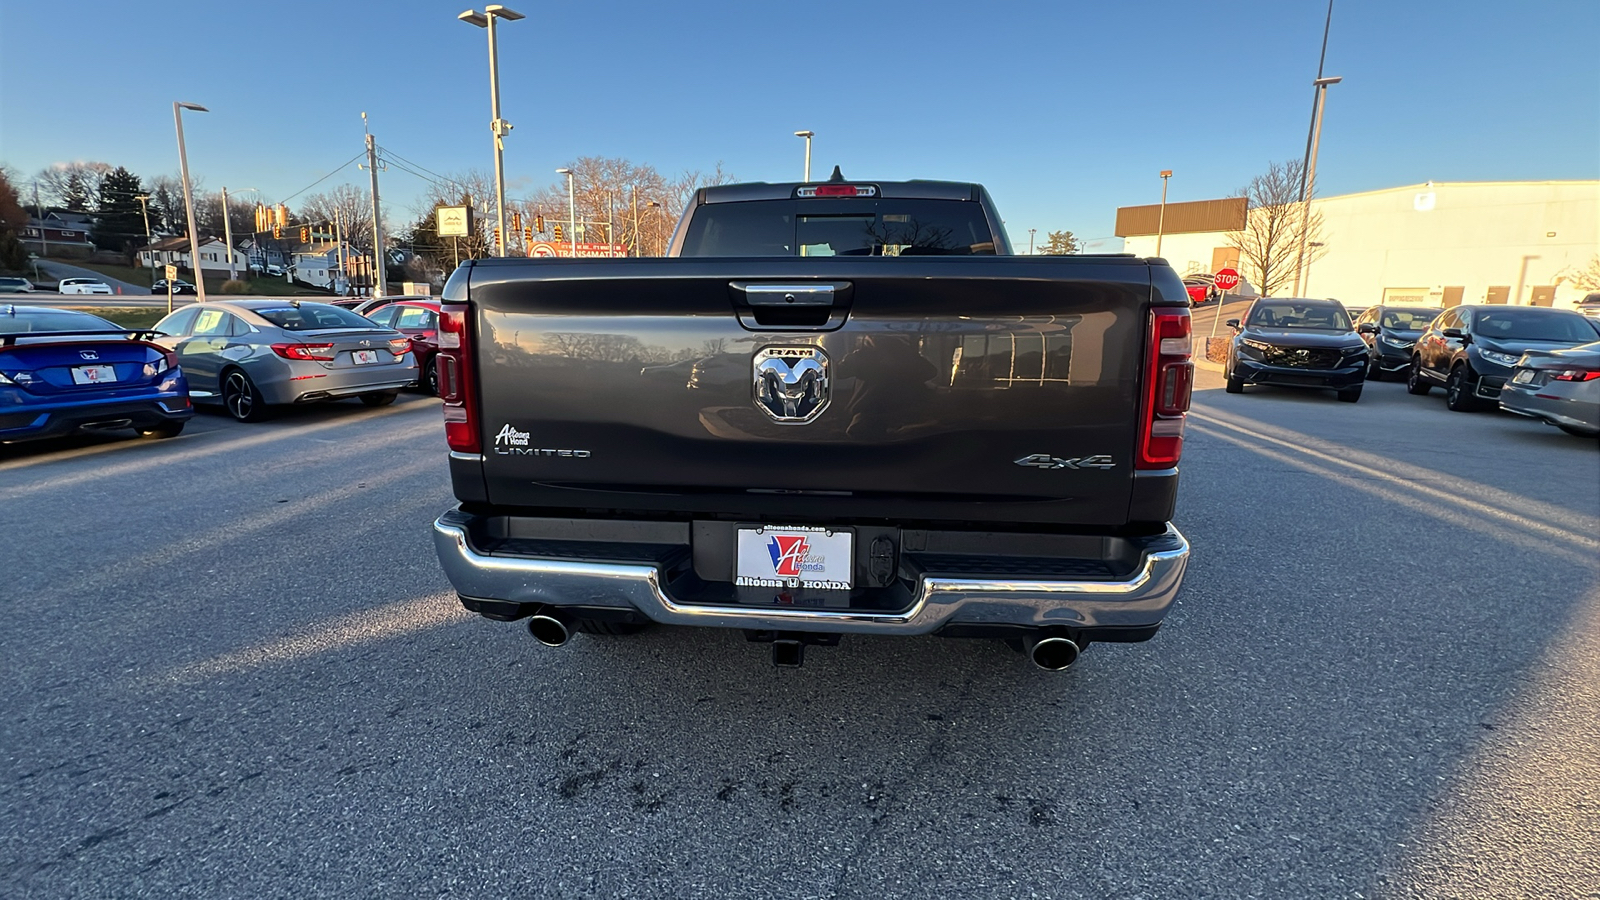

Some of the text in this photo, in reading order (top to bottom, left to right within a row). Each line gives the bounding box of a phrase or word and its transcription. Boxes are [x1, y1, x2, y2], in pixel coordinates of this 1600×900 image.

[558, 249, 626, 258] TRANS4MATON
[1215, 274, 1238, 284] STOP
[494, 447, 591, 458] LIMITED
[775, 539, 825, 571] Altoona
[796, 562, 824, 571] Honda
[735, 577, 852, 590] Altoona HONDA
